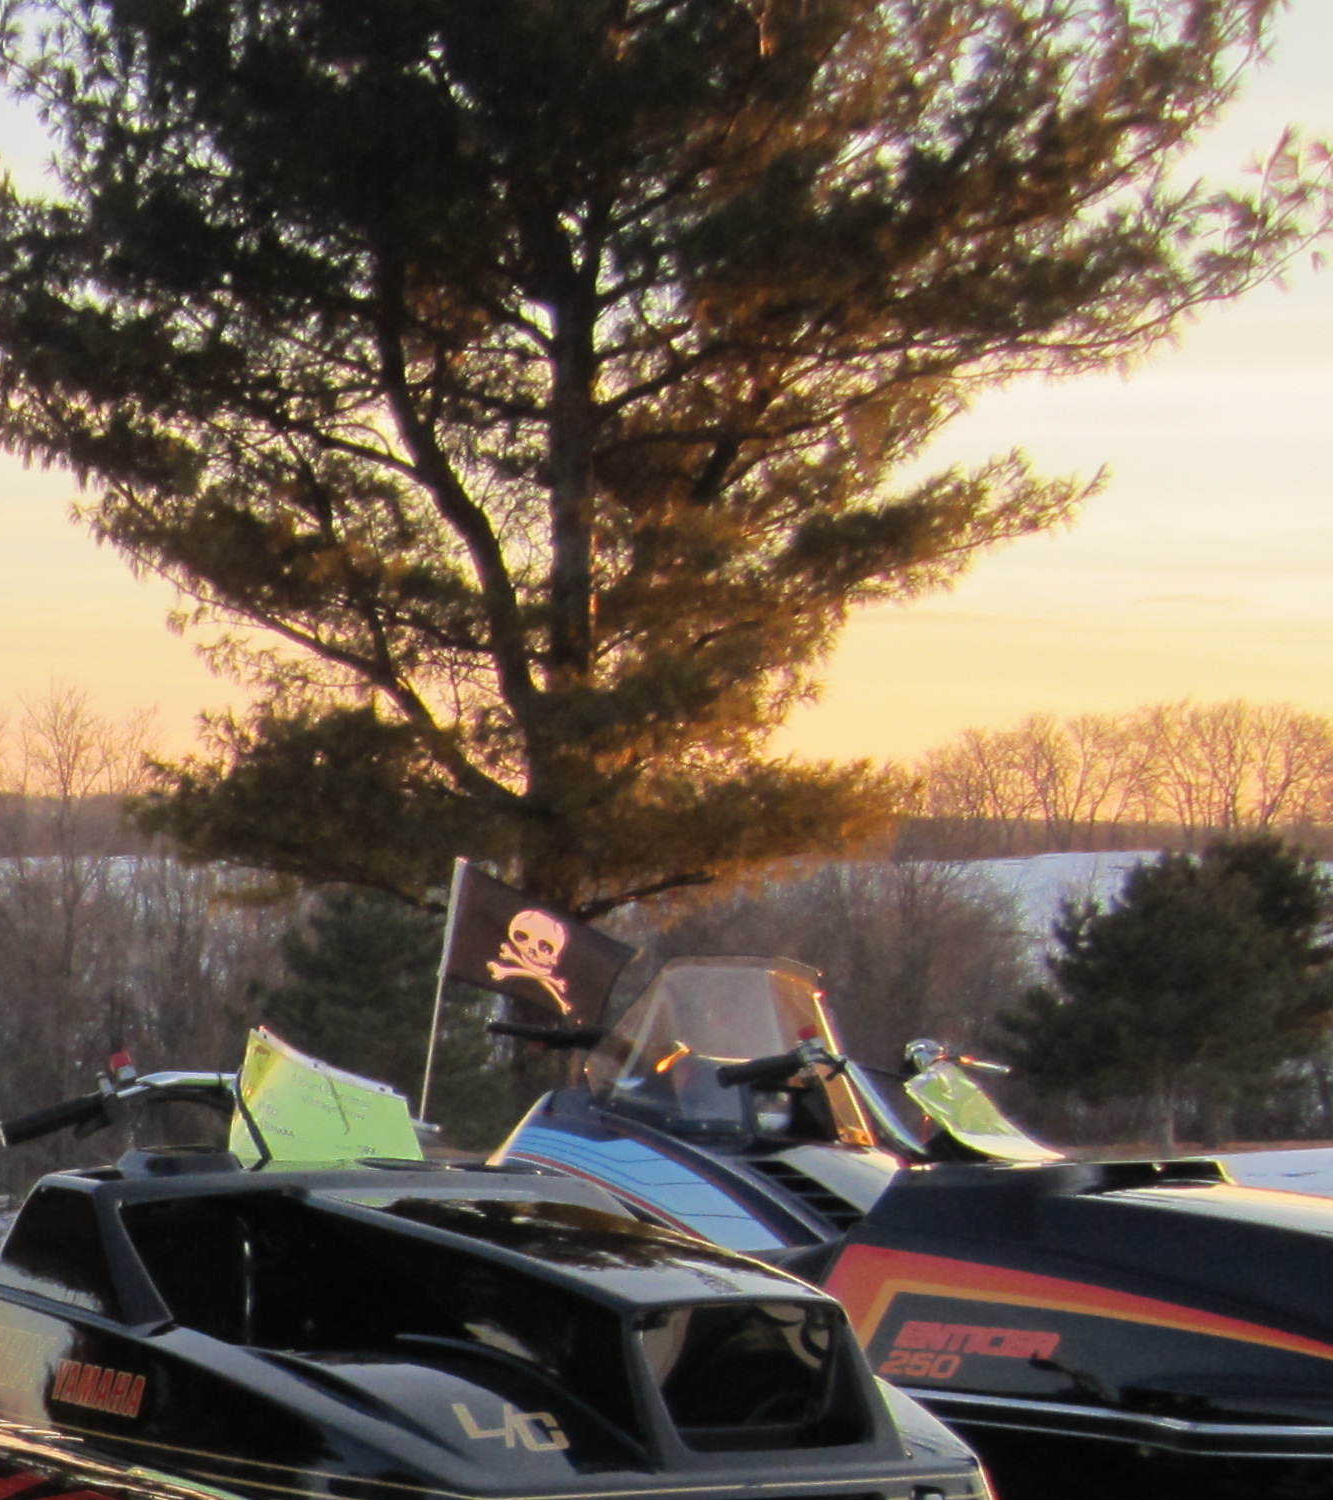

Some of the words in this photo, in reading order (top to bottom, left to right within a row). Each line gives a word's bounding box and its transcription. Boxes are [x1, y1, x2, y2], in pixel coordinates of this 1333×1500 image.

[893, 1320, 1061, 1360] ENTICER
[879, 1350, 962, 1379] 250
[52, 1358, 146, 1418] YAMAHA
